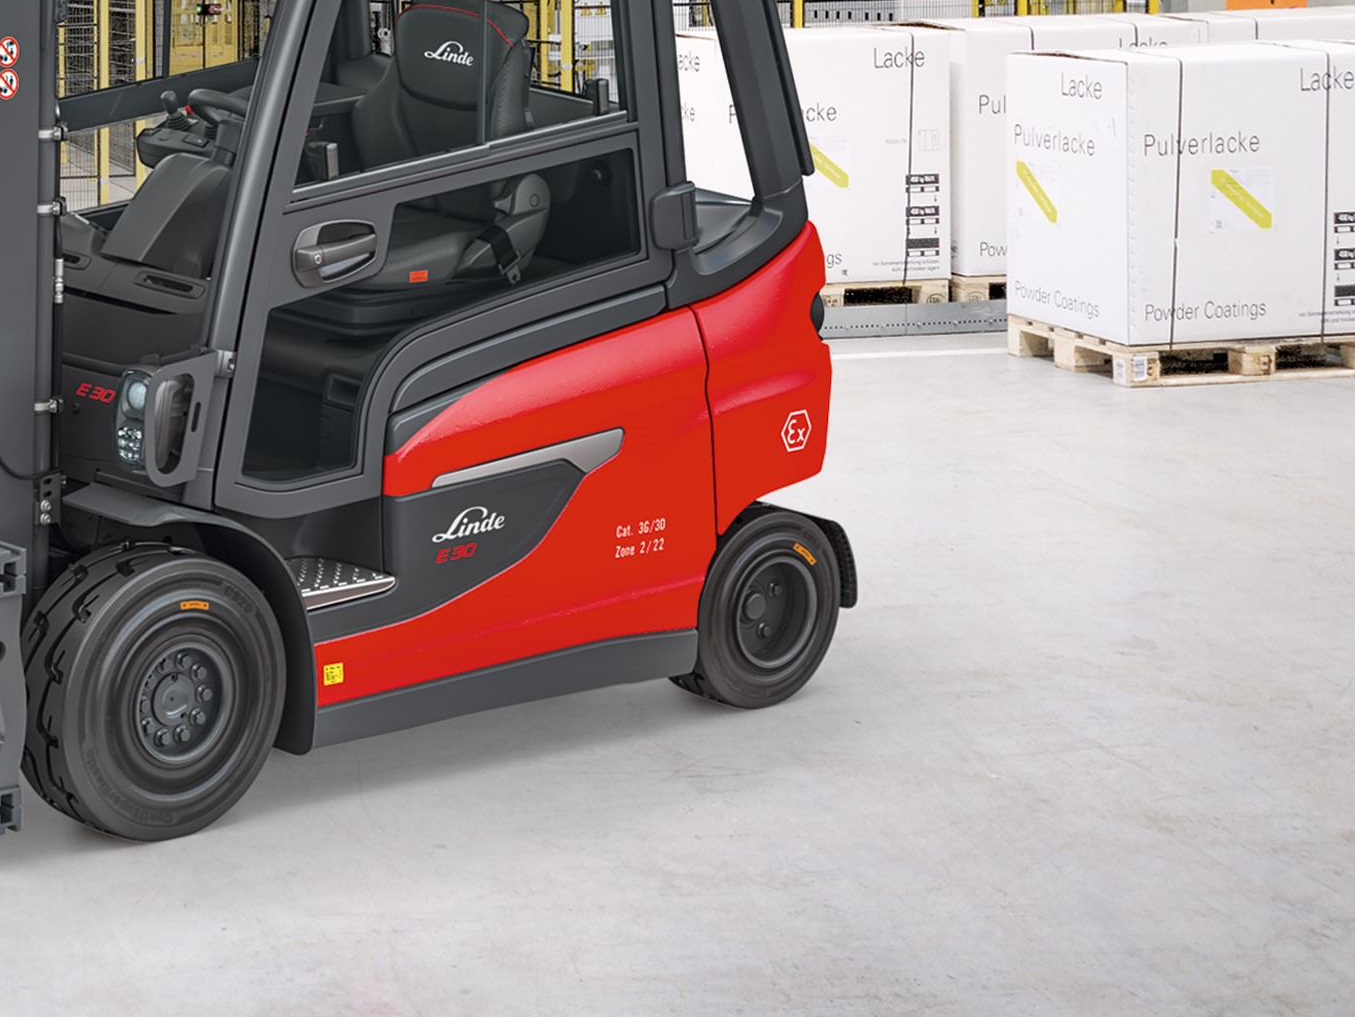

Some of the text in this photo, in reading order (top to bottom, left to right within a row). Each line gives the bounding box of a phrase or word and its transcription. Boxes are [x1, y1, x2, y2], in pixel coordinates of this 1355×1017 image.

[424, 40, 474, 66] Linde
[678, 50, 700, 72] acke
[873, 46, 925, 69] Lacke
[1060, 72, 1103, 100] Lacke
[1300, 65, 1355, 91] Lacke
[1014, 123, 1096, 156] Pulverlacke
[1144, 131, 1260, 157] Pulverlacke
[1015, 280, 1100, 319] Powder Coatings
[1145, 300, 1267, 322] Powder Coatings
[431, 506, 506, 543] Linde
[615, 545, 636, 559] Zone
